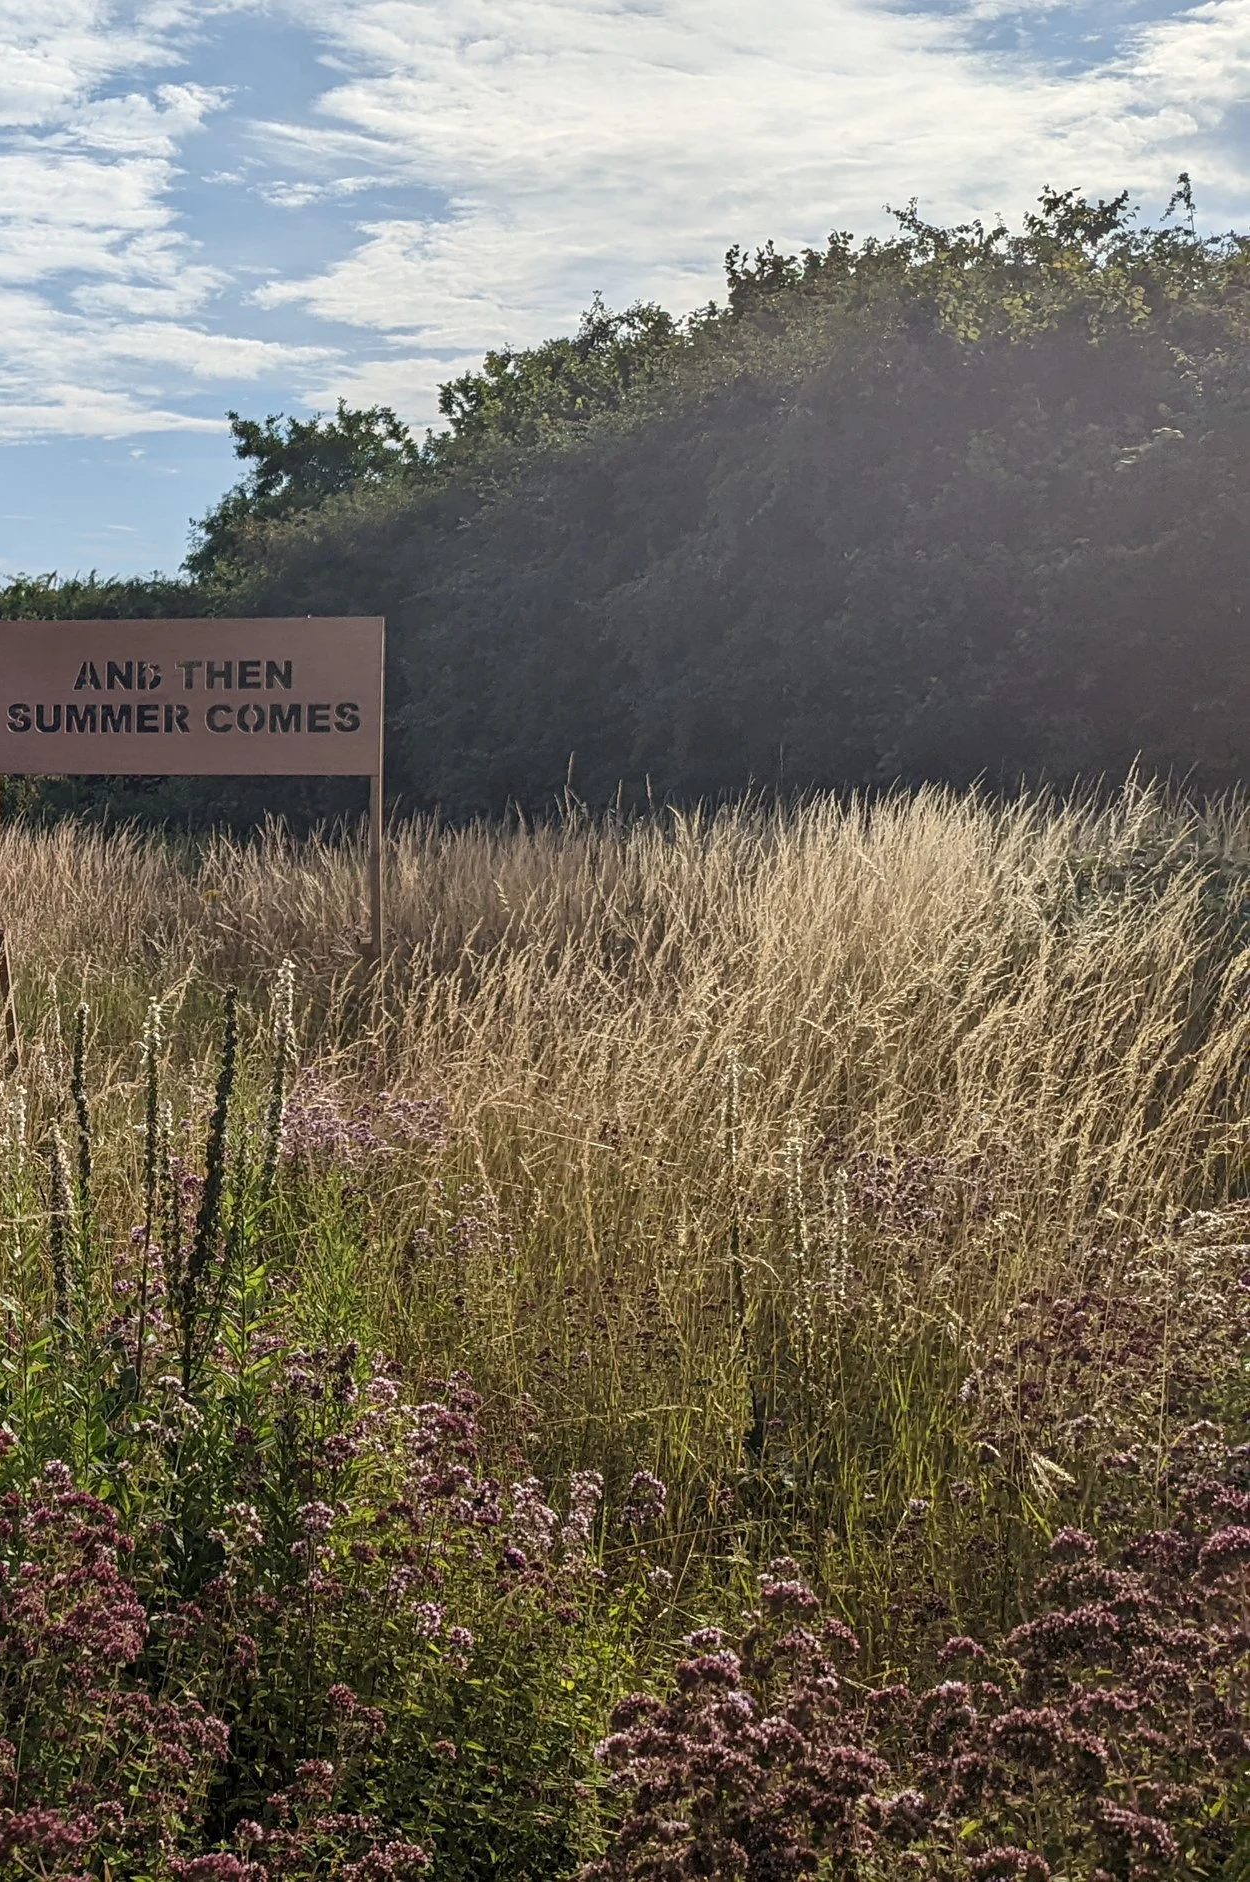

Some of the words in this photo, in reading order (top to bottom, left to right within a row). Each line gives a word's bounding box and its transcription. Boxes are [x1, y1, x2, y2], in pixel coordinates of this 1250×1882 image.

[73, 660, 162, 691] AND
[174, 660, 293, 691] THEN
[6, 703, 190, 734] SUMMER
[204, 702, 361, 734] COMES
